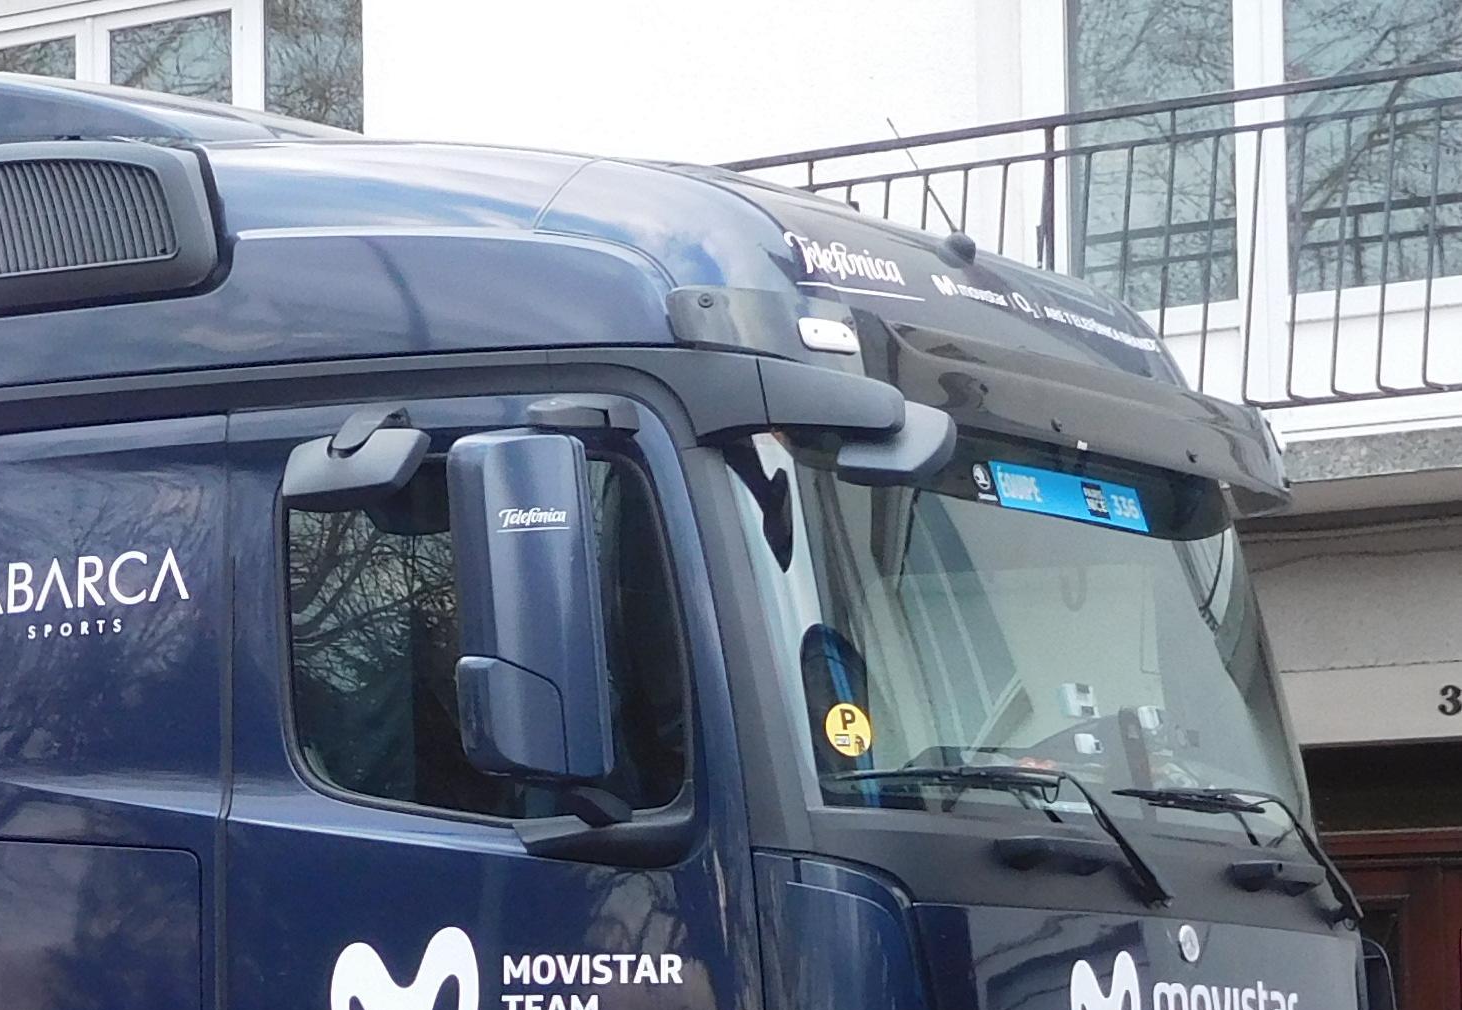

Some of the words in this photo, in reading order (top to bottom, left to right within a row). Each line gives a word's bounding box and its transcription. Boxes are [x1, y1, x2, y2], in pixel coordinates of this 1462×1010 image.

[27, 618, 122, 639] SPORTS
[1438, 685, 1461, 716] 3
[503, 954, 683, 985] MOVISTAR
